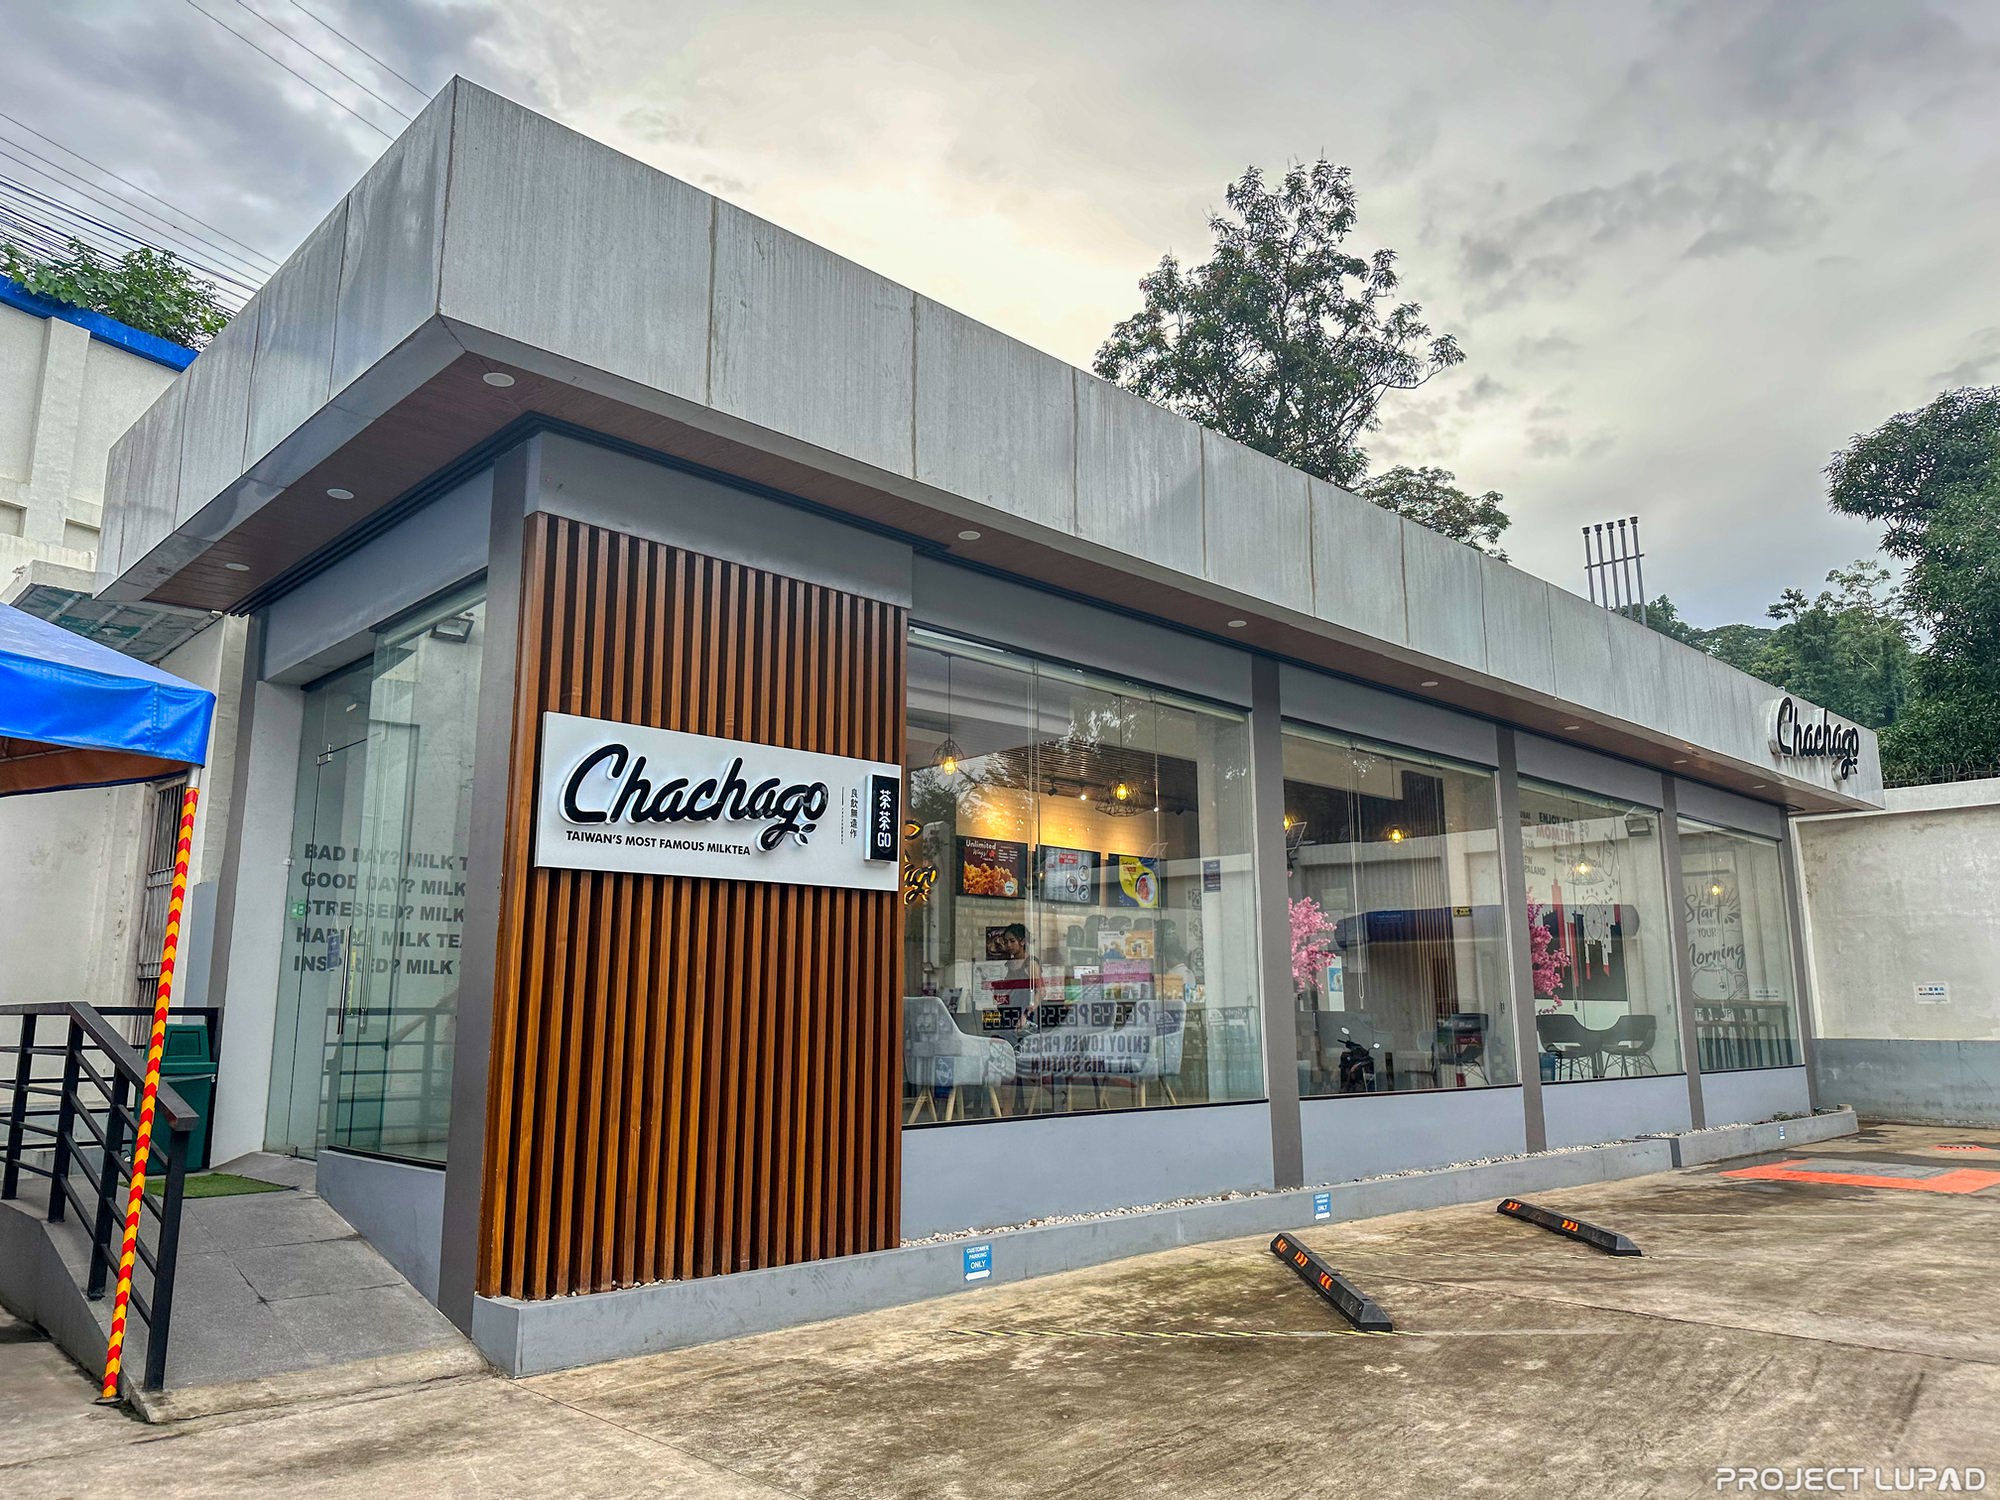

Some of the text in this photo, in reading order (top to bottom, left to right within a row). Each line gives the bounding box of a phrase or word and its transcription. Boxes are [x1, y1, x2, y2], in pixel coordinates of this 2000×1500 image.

[1772, 696, 1859, 780] Chachago
[561, 743, 829, 852] Chachago
[566, 830, 751, 856] TAIWAN'S MOST FAMOUS MILKTEA
[965, 839, 997, 850] Unlimited
[304, 843, 346, 861] BAD
[407, 852, 454, 870] MILK
[301, 871, 357, 889] GOOD
[421, 880, 466, 897] MILK
[420, 906, 464, 923] MILK
[1685, 894, 1728, 926] Start
[381, 931, 431, 948] MILK
[436, 933, 462, 949] TE
[406, 958, 453, 975] MILK
[970, 1259, 986, 1270] ONLY
